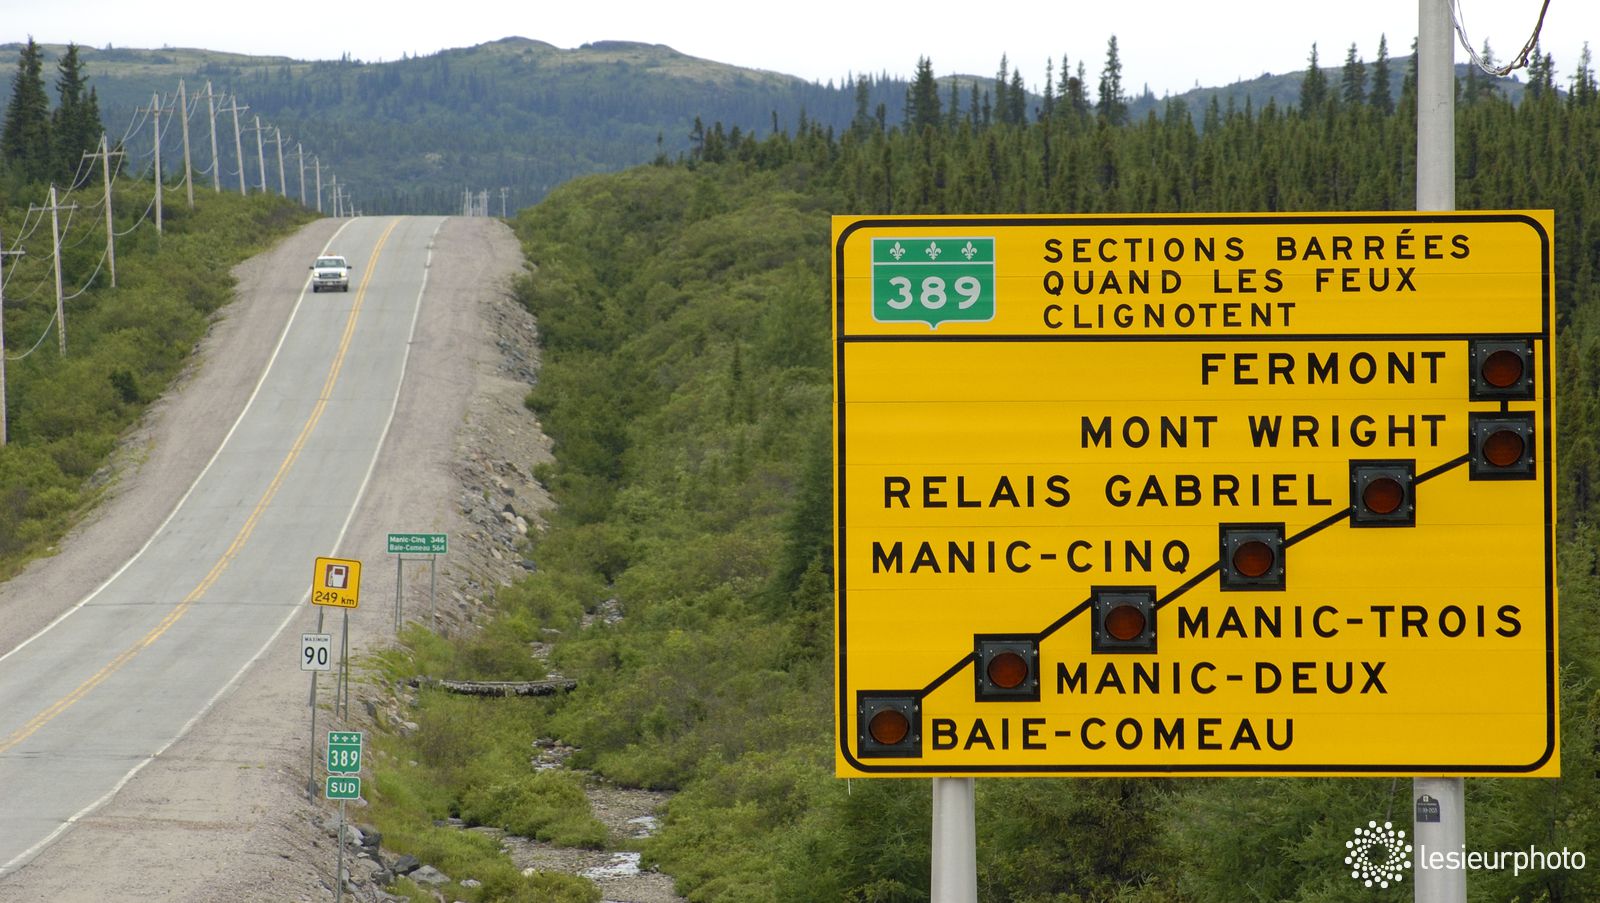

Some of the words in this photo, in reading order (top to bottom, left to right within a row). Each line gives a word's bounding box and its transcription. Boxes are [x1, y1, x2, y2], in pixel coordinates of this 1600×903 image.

[1044, 237, 1244, 264] SECTIONS
[1277, 229, 1470, 261] BARRÉES
[886, 276, 981, 310] 389
[1043, 269, 1182, 295] QUAND
[1213, 268, 1283, 294] LES
[1315, 267, 1417, 293] FEUX
[1043, 303, 1296, 329] CLIGNOTENT
[1201, 351, 1446, 386] FERMONT
[1081, 415, 1218, 449] MONT
[1249, 414, 1446, 448] WRIGHT
[884, 475, 1071, 509] RELAIS
[1105, 473, 1332, 507] GABRIEL
[389, 536, 426, 544] Manic-Cinq
[389, 543, 430, 551] Baie-Comeau
[872, 539, 1192, 574] MANIC-CINQ
[315, 590, 338, 603] 249
[341, 596, 355, 605] km
[1178, 604, 1522, 639] MANIC-TROIS
[304, 646, 328, 665] 90
[1056, 661, 1387, 695] MANIC-DEUX
[931, 717, 1294, 751] BAIE-COMEAU
[330, 750, 358, 767] 389
[330, 782, 356, 793] SUD
